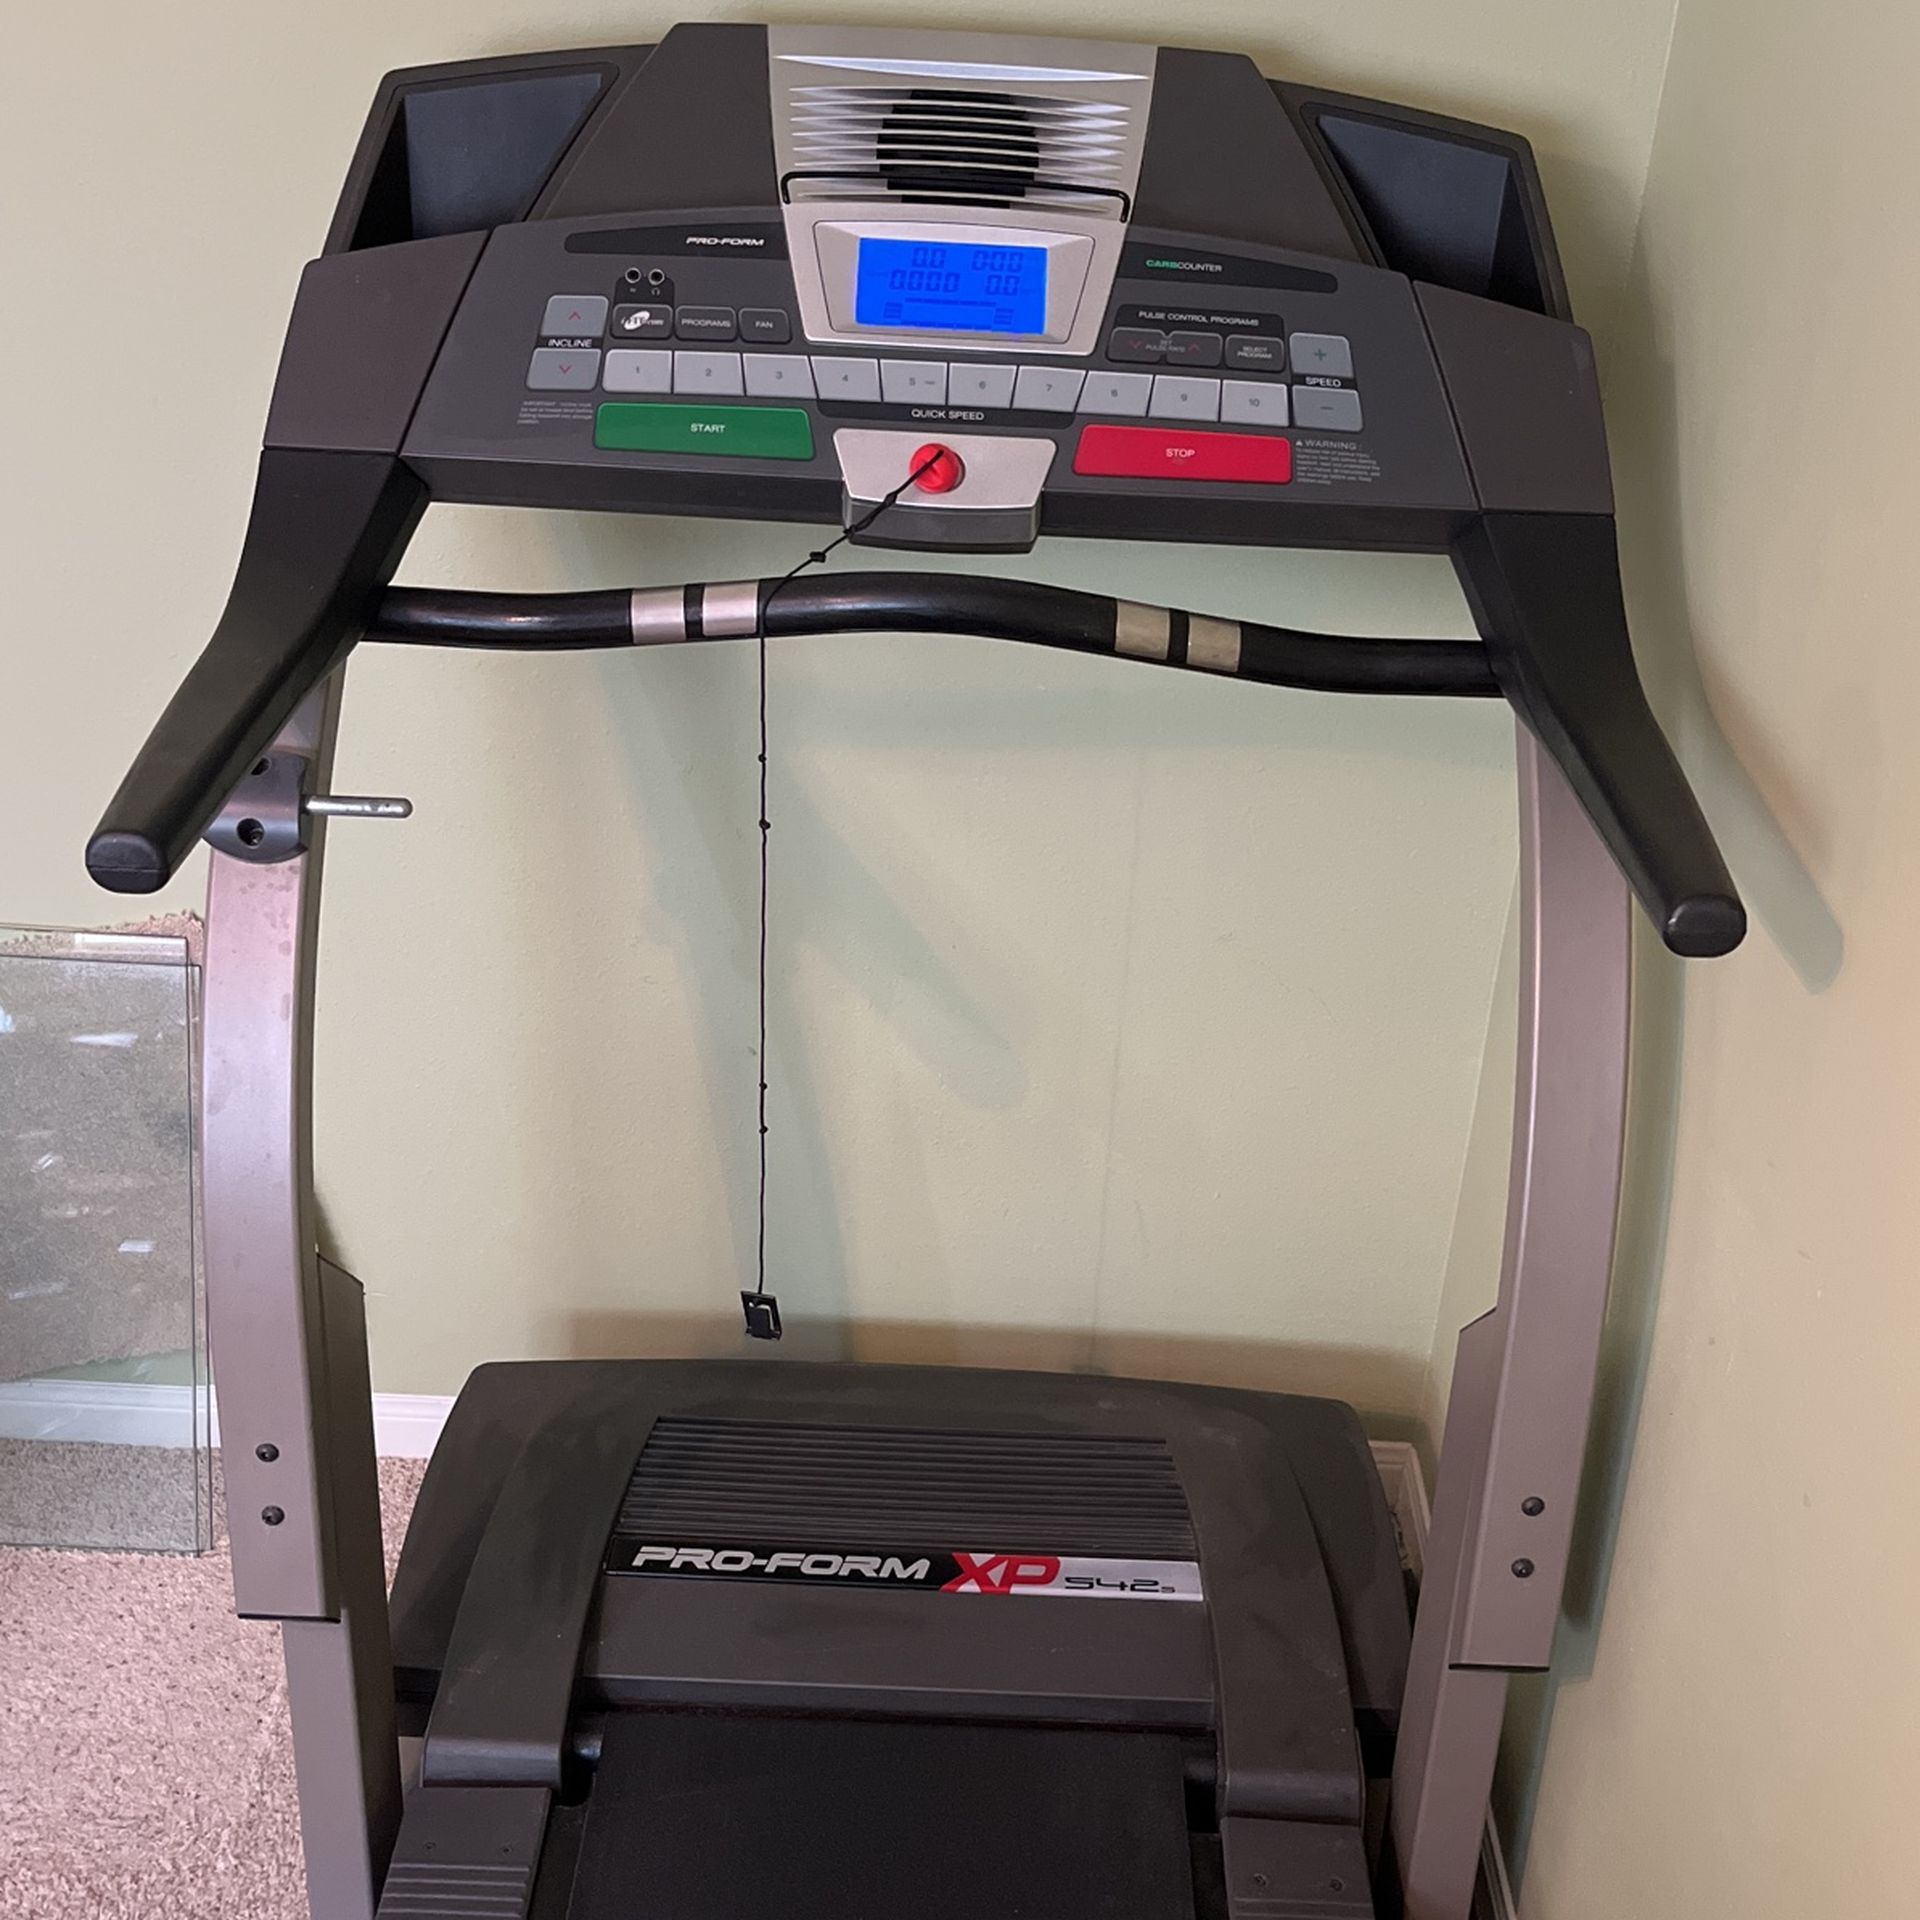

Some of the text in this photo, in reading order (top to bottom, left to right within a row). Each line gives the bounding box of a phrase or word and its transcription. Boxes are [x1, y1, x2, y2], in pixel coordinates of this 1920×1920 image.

[681, 318, 731, 328] PROGRAMS
[1138, 310, 1260, 327] PULSE CONTROL PROGRAMS
[755, 320, 773, 329] FAN
[548, 339, 593, 348] INCLINE
[705, 368, 712, 377] 2
[775, 371, 783, 380] 3
[842, 374, 849, 382] 4
[909, 377, 916, 386] 5
[1305, 376, 1342, 387] SPEED
[979, 380, 987, 390] 6
[1045, 384, 1053, 393] 7
[1180, 392, 1188, 402] 9
[1249, 398, 1260, 407] 10
[911, 408, 985, 421] QUICK SPEED
[690, 423, 726, 433] START
[1304, 439, 1357, 450] WARNING
[1165, 447, 1196, 458] STOP
[631, 1546, 931, 1581] PRO-FORM
[938, 1551, 1061, 1594] XP
